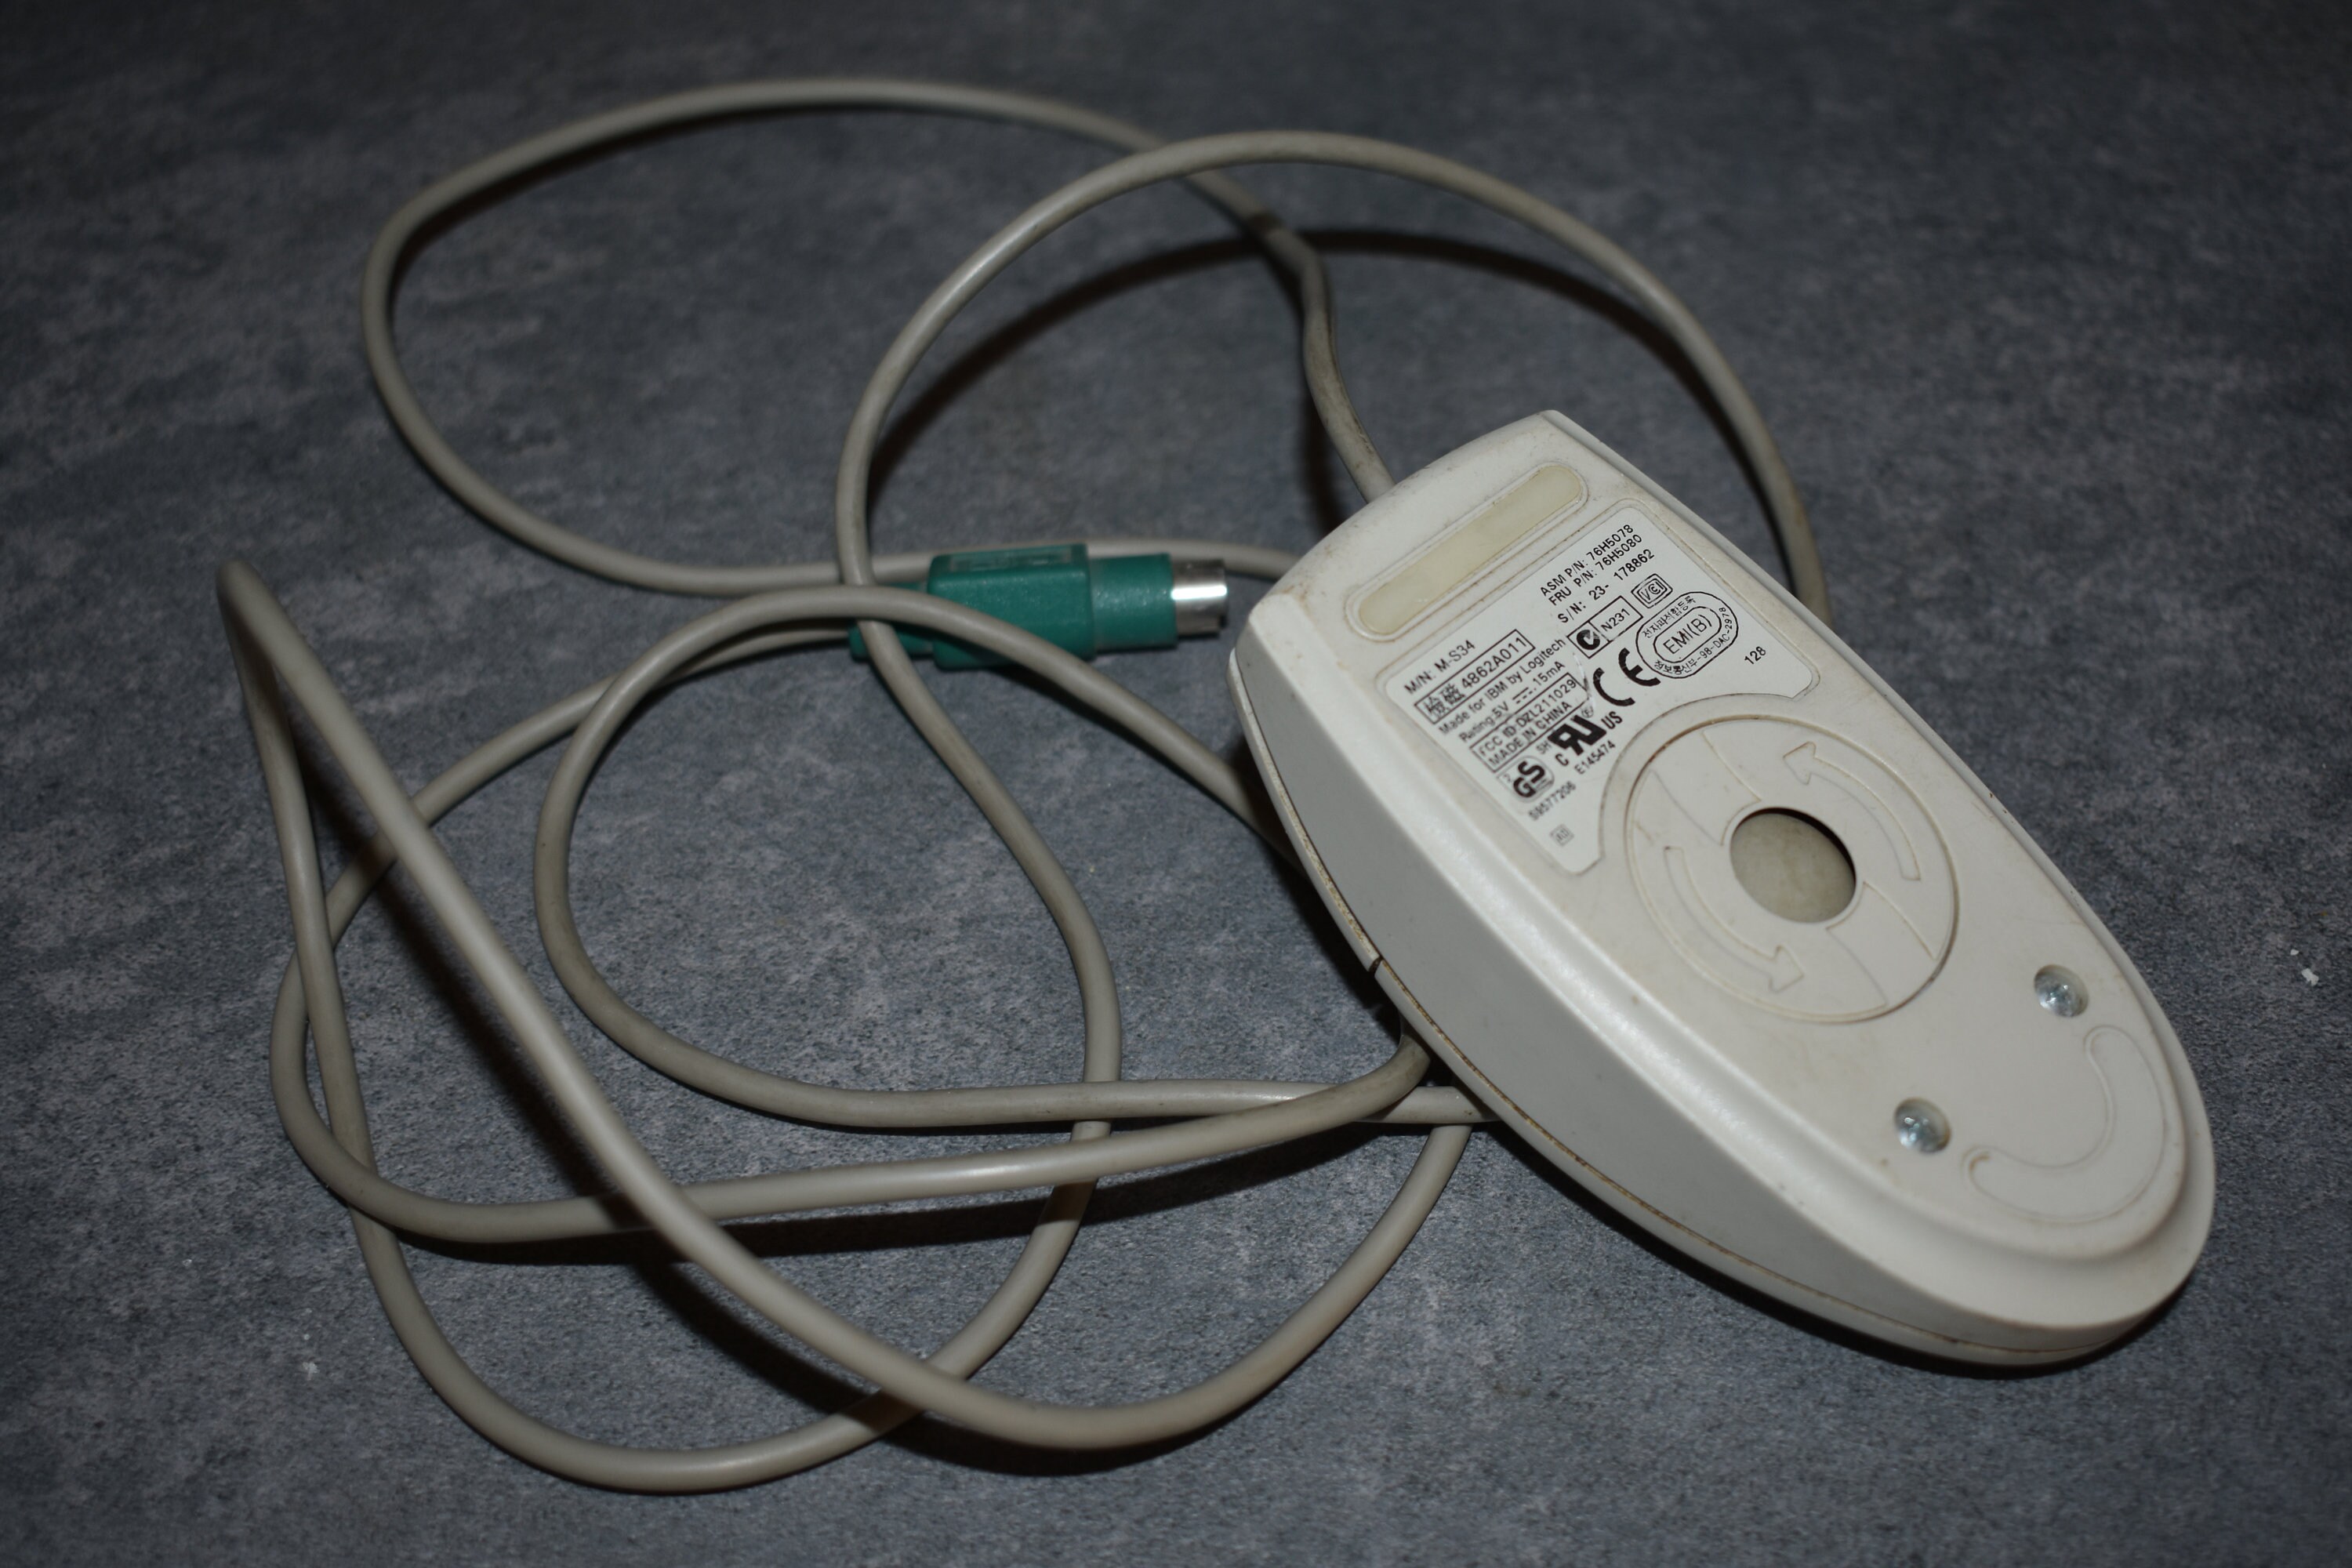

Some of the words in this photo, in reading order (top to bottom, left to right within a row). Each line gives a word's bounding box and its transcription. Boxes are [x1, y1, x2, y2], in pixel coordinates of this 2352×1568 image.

[1540, 575, 1566, 597] ASM
[1564, 559, 1588, 578] P/N:
[1586, 524, 1634, 561] 76H5078
[1548, 586, 1572, 606] FRU
[1573, 569, 1598, 587] P/N:
[1595, 534, 1642, 571] 76H5080
[1558, 601, 1586, 623] S/N:
[1613, 549, 1655, 581] 178862
[1601, 608, 1631, 632] N231
[1663, 614, 1712, 654] EMI(B)
[1404, 671, 1436, 695] M/N:
[1434, 640, 1475, 673] M-S34
[1461, 637, 1526, 689] 4862A011
[1593, 648, 1661, 706] CE
[1744, 646, 1766, 665] 128
[1439, 708, 1470, 735] Made
[1469, 698, 1486, 713] for
[1485, 681, 1508, 701] IBM
[1506, 670, 1523, 686] by
[1519, 637, 1566, 674] Logitech
[1479, 735, 1503, 757] FCC
[1489, 737, 1523, 767] MADE
[1522, 725, 1537, 742] IN
[1535, 701, 1572, 731] CHINA
[1601, 710, 1623, 730] US
[1574, 740, 1616, 775] E145474
